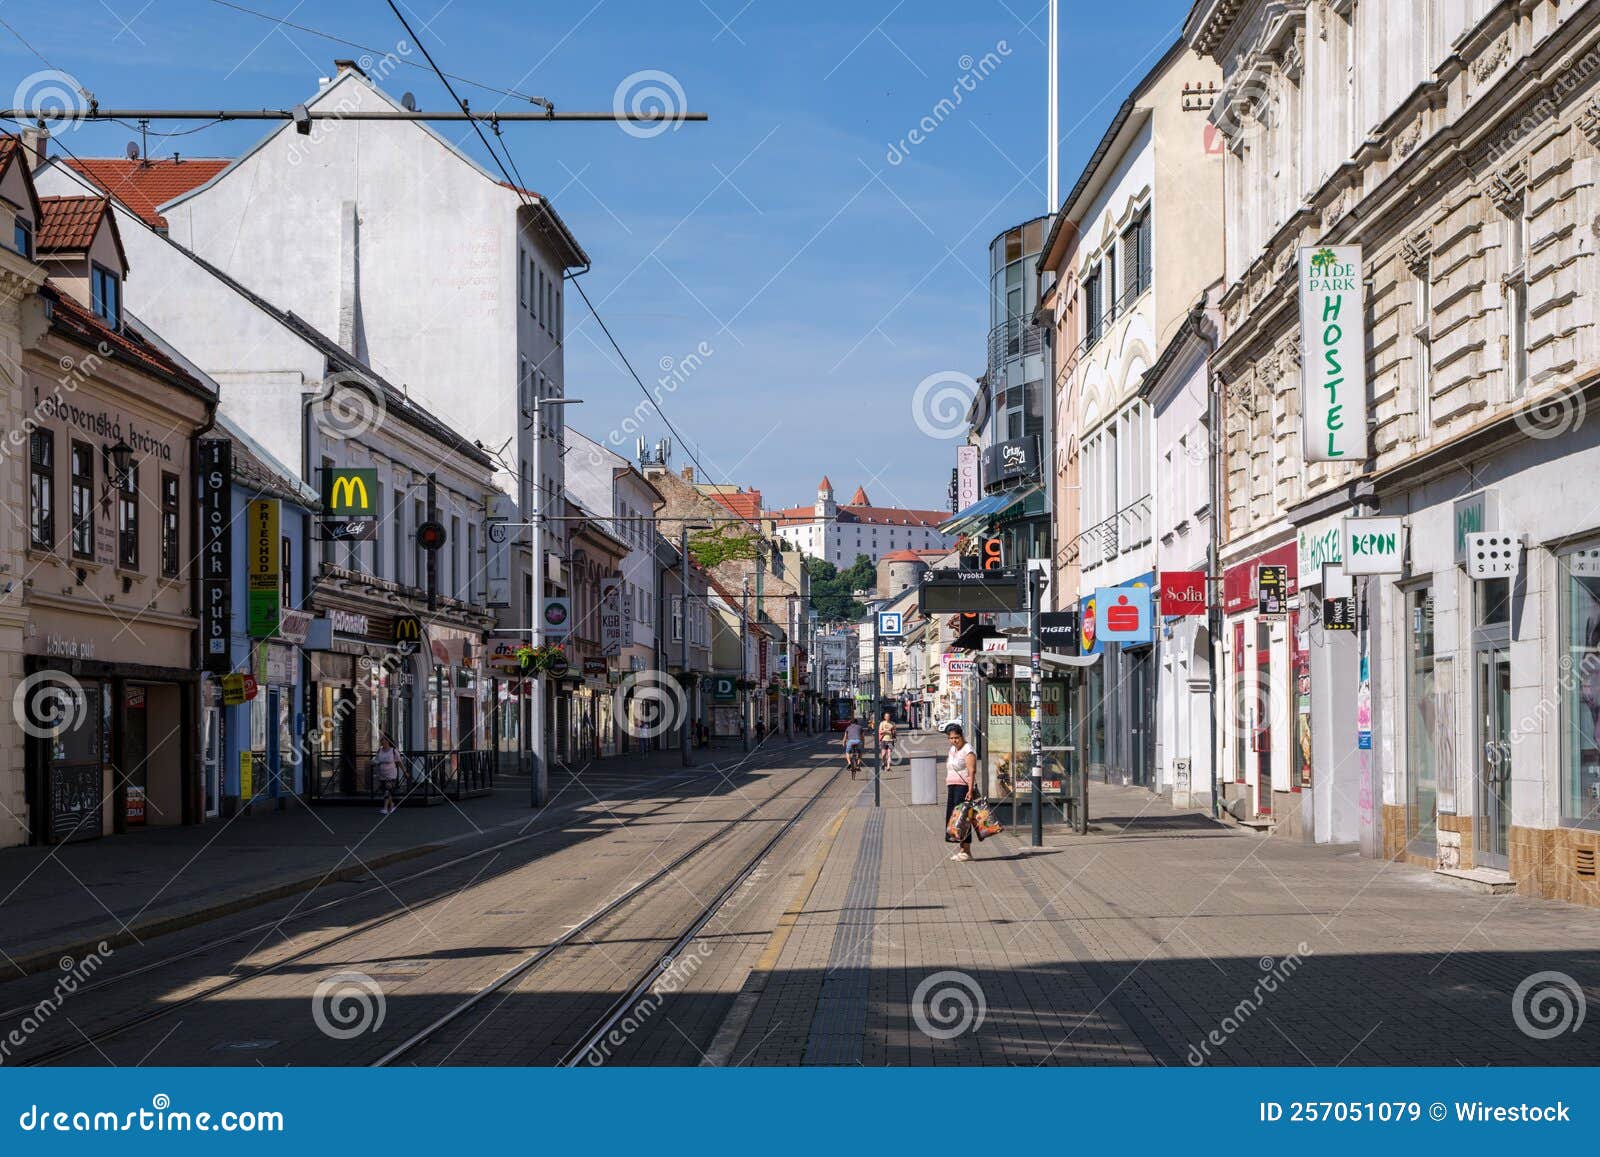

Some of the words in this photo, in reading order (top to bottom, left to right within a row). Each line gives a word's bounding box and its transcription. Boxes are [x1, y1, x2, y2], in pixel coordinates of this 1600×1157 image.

[1309, 278, 1356, 292] PARK
[1322, 294, 1345, 457] HOSTEL
[208, 472, 223, 573] Slovak
[259, 503, 269, 573] PRIECHOD
[1352, 533, 1396, 556] BEPON
[1310, 528, 1342, 572] HOSTEL
[957, 571, 985, 581] Vysoká
[1478, 563, 1511, 572] SIX
[1166, 586, 1204, 602] Sofia
[211, 587, 223, 637] pub
[603, 615, 620, 627] KGB
[606, 628, 620, 639] PUB
